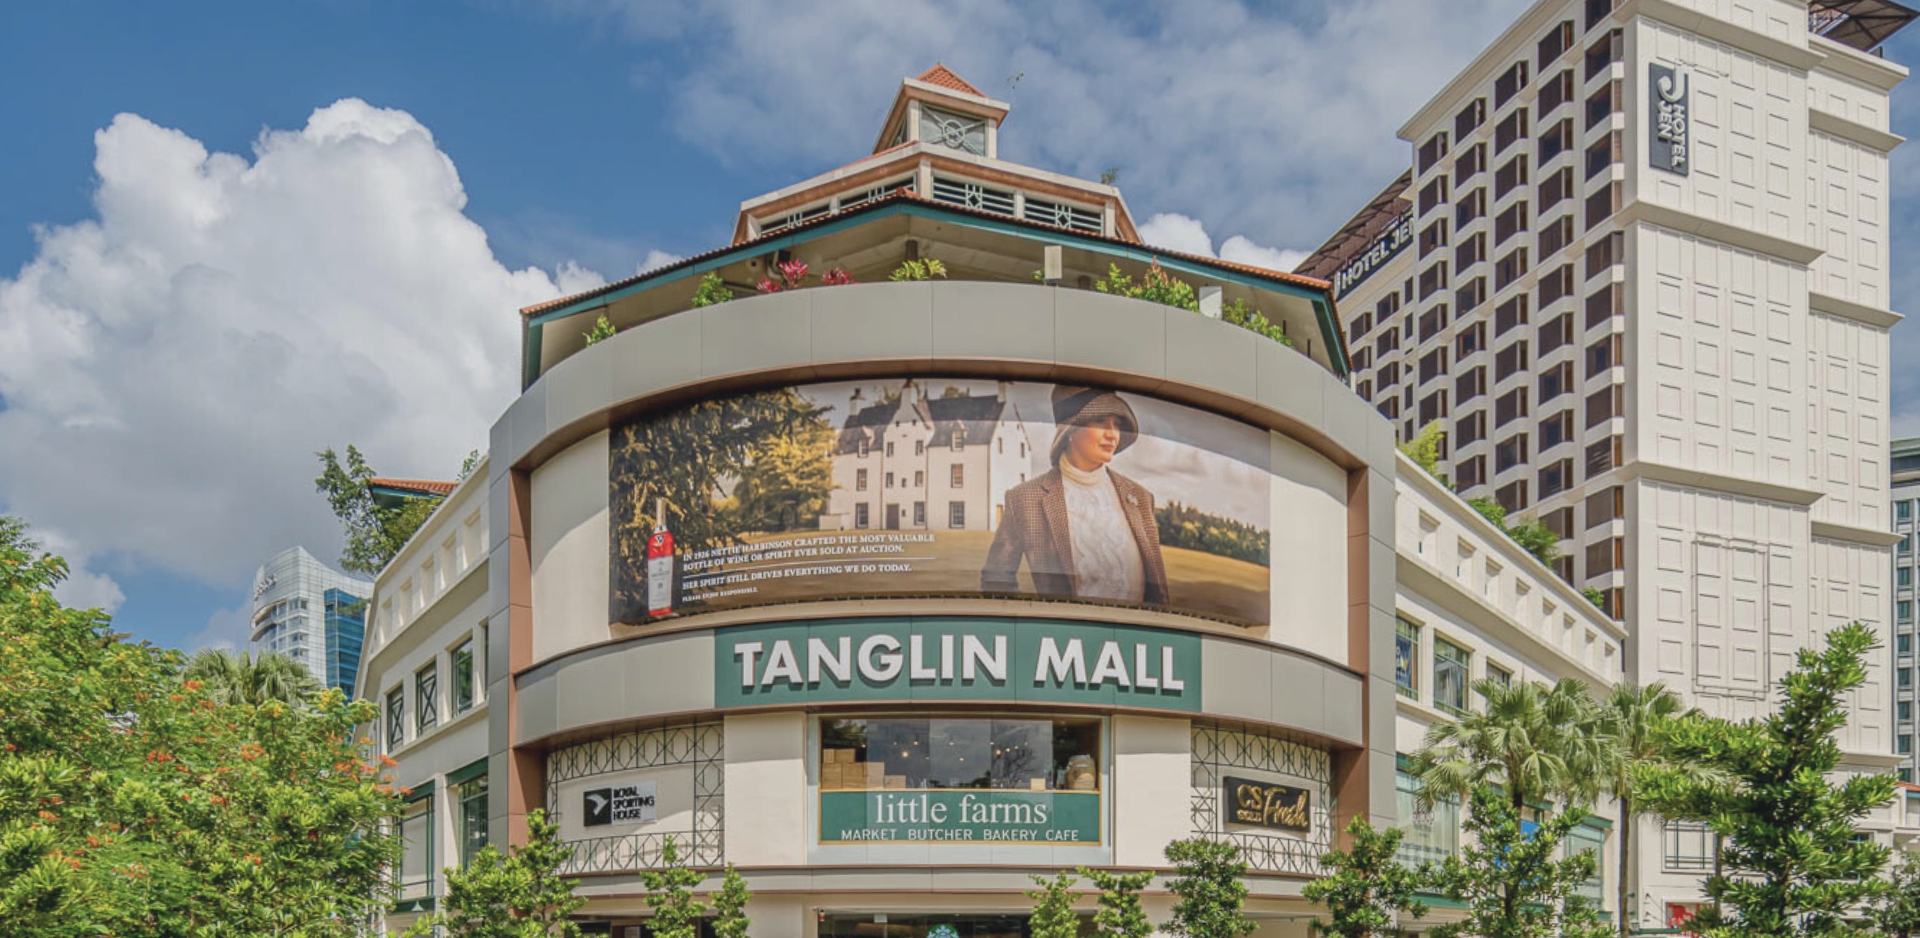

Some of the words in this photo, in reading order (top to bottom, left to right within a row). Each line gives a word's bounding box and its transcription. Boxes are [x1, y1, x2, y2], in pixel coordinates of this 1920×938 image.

[1658, 100, 1672, 141] JEN
[1671, 104, 1685, 167] HOTEL
[1341, 241, 1389, 290] HOTEL
[683, 552, 692, 562] IN
[694, 550, 709, 560] 1926
[711, 545, 740, 557] NETTIE
[794, 536, 836, 547] CRAFTED
[839, 535, 858, 544] THE
[860, 534, 886, 543] MOST
[888, 533, 935, 543] VALUABLE
[683, 560, 713, 572] BOTTLE
[714, 558, 725, 567] OF
[727, 555, 748, 565] WINE
[751, 553, 763, 562] OR
[765, 550, 792, 560] SPIRIT
[794, 547, 818, 558] EVER
[820, 546, 843, 555] SOLD
[846, 545, 858, 555] AT
[860, 544, 905, 553] AUCTION.
[682, 581, 699, 590] HER
[699, 576, 725, 588] SPIRIT
[727, 572, 750, 584] STILL
[751, 569, 783, 581] DRIVES
[784, 564, 842, 578] EVERYTHING
[844, 564, 859, 574] WE
[861, 564, 876, 573] DO
[878, 563, 913, 573] TODAY.
[682, 594, 701, 602] PLEASE
[702, 591, 720, 600] ENJOY
[734, 634, 1008, 687] TANGLIN
[1033, 637, 1186, 691] MALL
[613, 786, 640, 798] ROYAL
[613, 795, 655, 810] SPORTING
[1237, 784, 1263, 811] CS
[1263, 786, 1308, 828] Fresh
[613, 808, 642, 821] HOUSE
[875, 793, 948, 824] little
[959, 794, 1048, 824] farms
[841, 829, 897, 841] MARKET
[908, 829, 973, 841] BUTCHER
[983, 829, 1038, 841] BAKERY
[1045, 829, 1079, 841] CAFE
